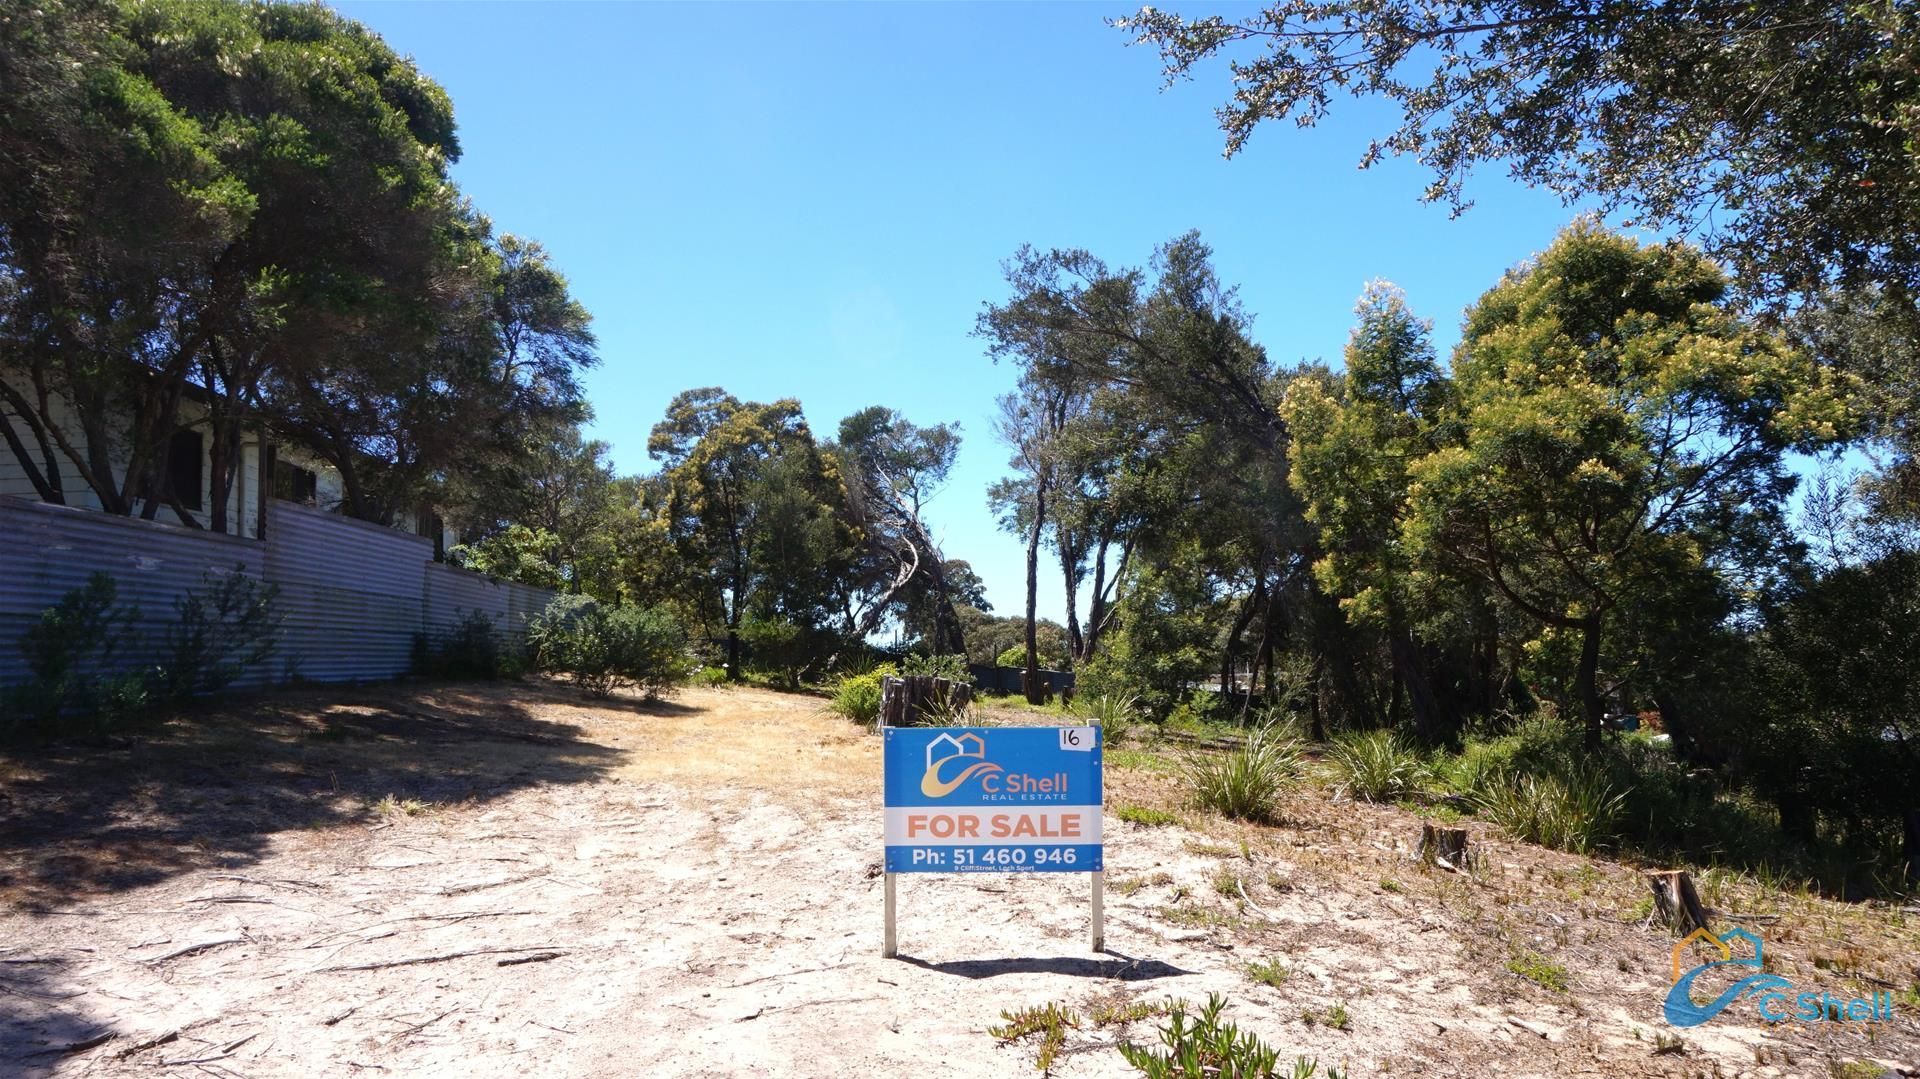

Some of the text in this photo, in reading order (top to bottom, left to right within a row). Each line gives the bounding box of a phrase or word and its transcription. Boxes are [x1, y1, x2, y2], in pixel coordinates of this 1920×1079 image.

[1063, 730, 1080, 746] 16
[982, 773, 1067, 793] C Shell
[1021, 793, 1067, 801] ESTATE
[908, 814, 1081, 838] FOR SALE
[912, 848, 1077, 864] Ph: 51 460 946
